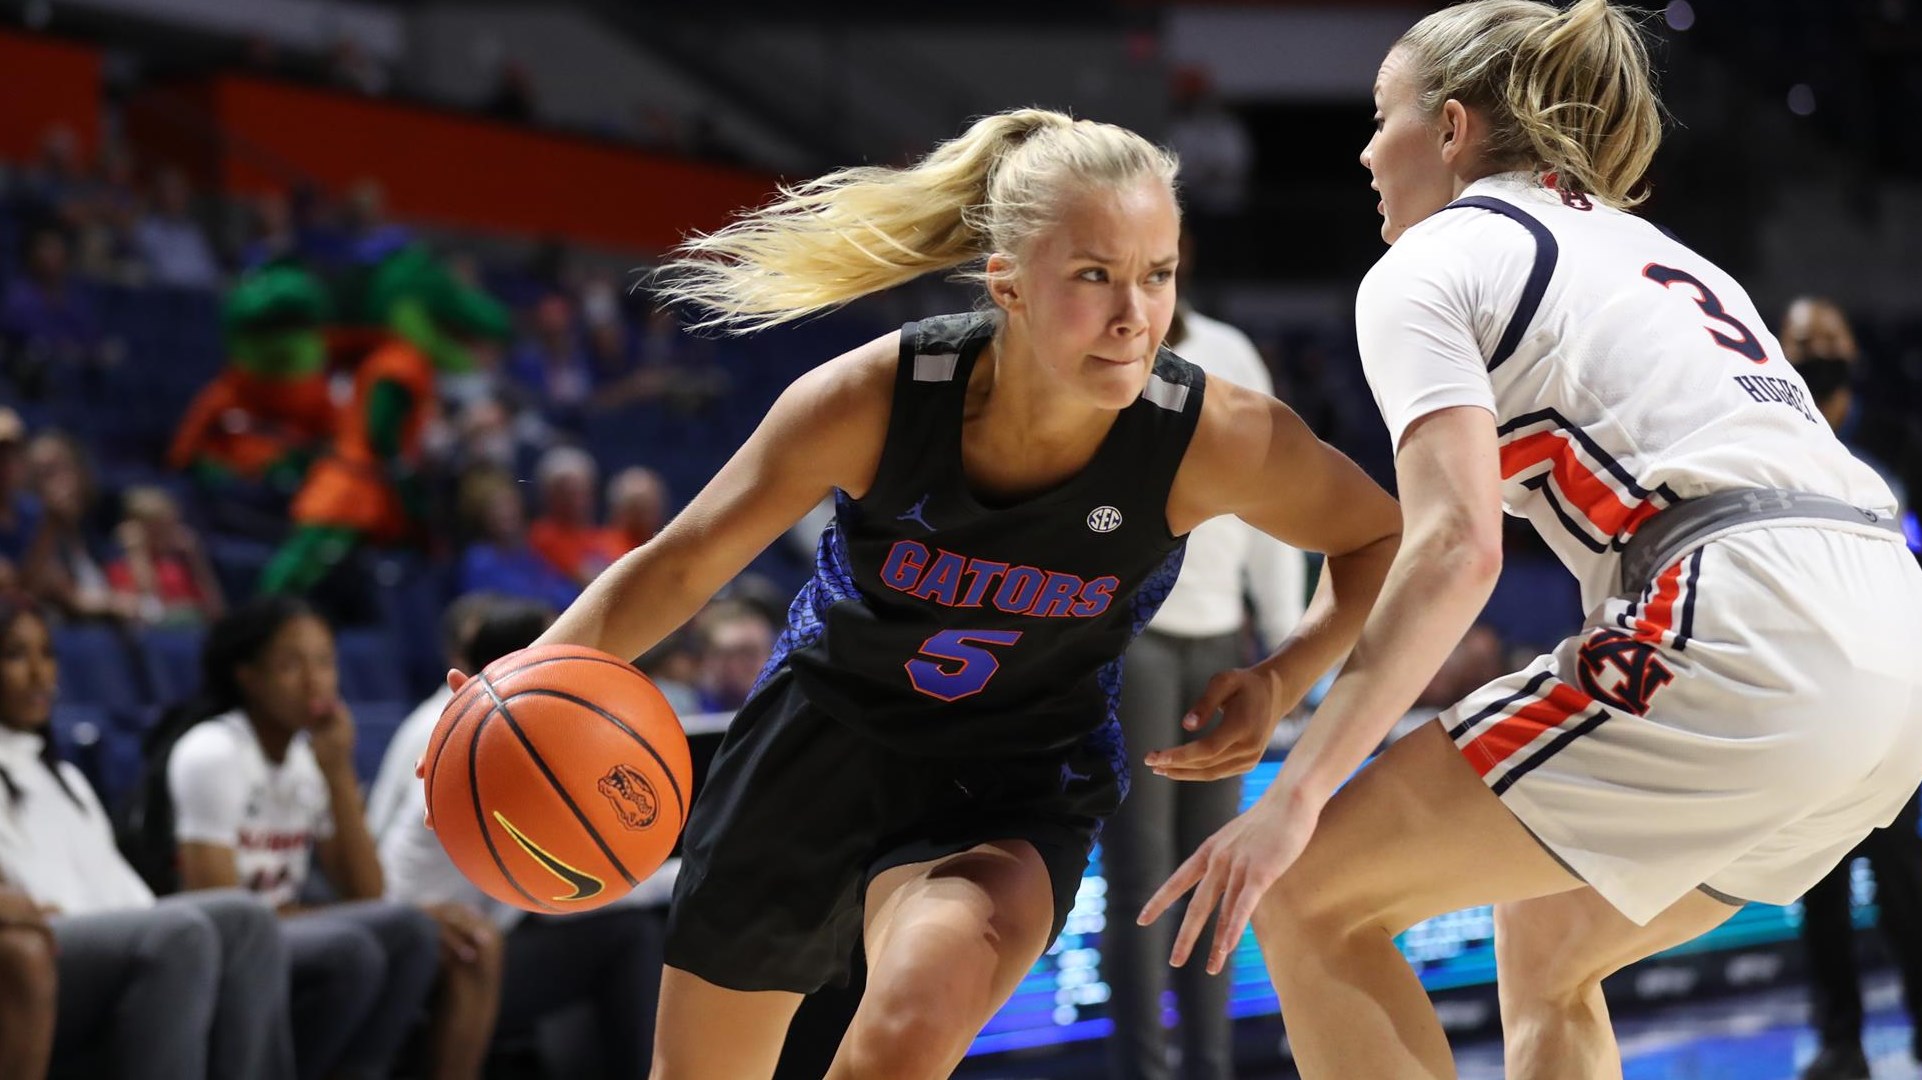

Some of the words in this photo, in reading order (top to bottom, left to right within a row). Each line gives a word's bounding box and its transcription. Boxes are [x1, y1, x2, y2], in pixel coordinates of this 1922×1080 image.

[1642, 262, 1768, 364] 3
[1089, 507, 1121, 531] SEC
[880, 540, 1120, 618] GATORS
[904, 629, 1023, 702] 5
